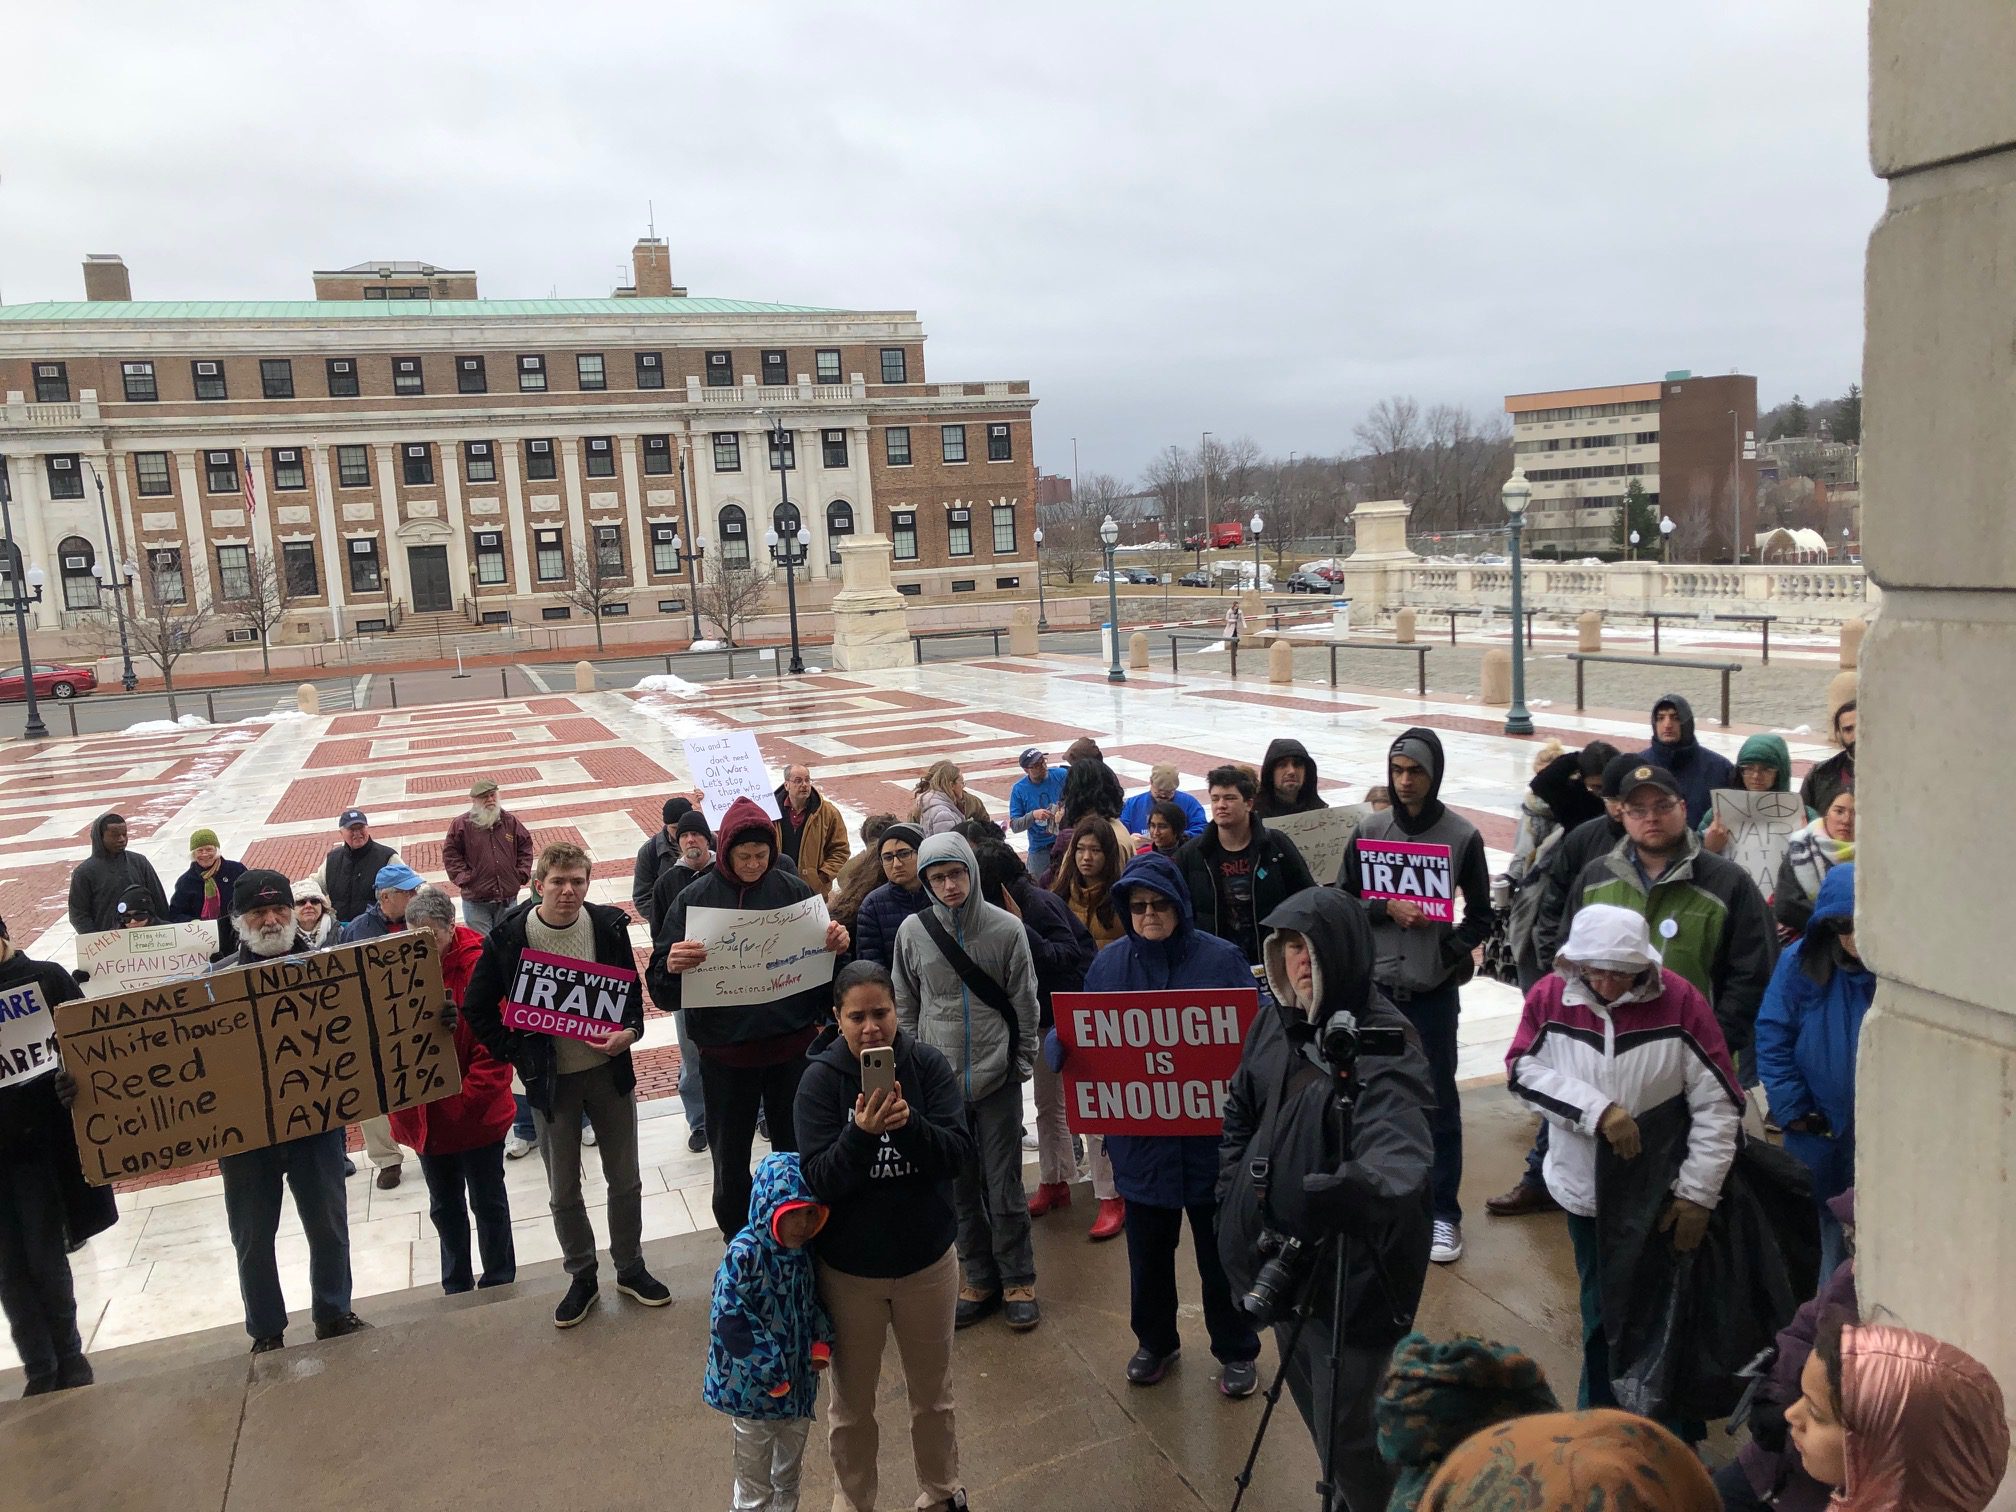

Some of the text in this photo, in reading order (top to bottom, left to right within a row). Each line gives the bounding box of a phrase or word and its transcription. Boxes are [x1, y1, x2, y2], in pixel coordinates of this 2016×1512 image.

[690, 738, 731, 753] You and I
[732, 751, 749, 761] need
[702, 776, 743, 789] Let's stop
[705, 766, 721, 778] Oil
[717, 780, 761, 797] those who
[1360, 850, 1449, 870] PEACE WITH
[1361, 863, 1451, 899] IRAN
[80, 930, 122, 960] YEMEN
[132, 931, 168, 943] Bring the
[184, 923, 218, 949] SYRIA
[94, 952, 209, 976] AFGHANISTAN
[521, 960, 631, 994] PEACE WITH
[91, 987, 189, 1028] NAME
[259, 954, 346, 993] NDAA
[513, 973, 628, 1024] IRAN
[72, 1011, 250, 1066] Whitehouse
[380, 962, 425, 1001] 1%
[1072, 1005, 1241, 1048] ENOUGH
[91, 1047, 207, 1105] Reed
[387, 995, 434, 1037] 1%
[1145, 1051, 1175, 1075] IS
[86, 1090, 217, 1145] Cicilline
[390, 1032, 441, 1073] 1%
[1075, 1079, 1232, 1120] ENOUGH
[98, 1125, 245, 1179] Langevin
[393, 1063, 445, 1108] 1%
